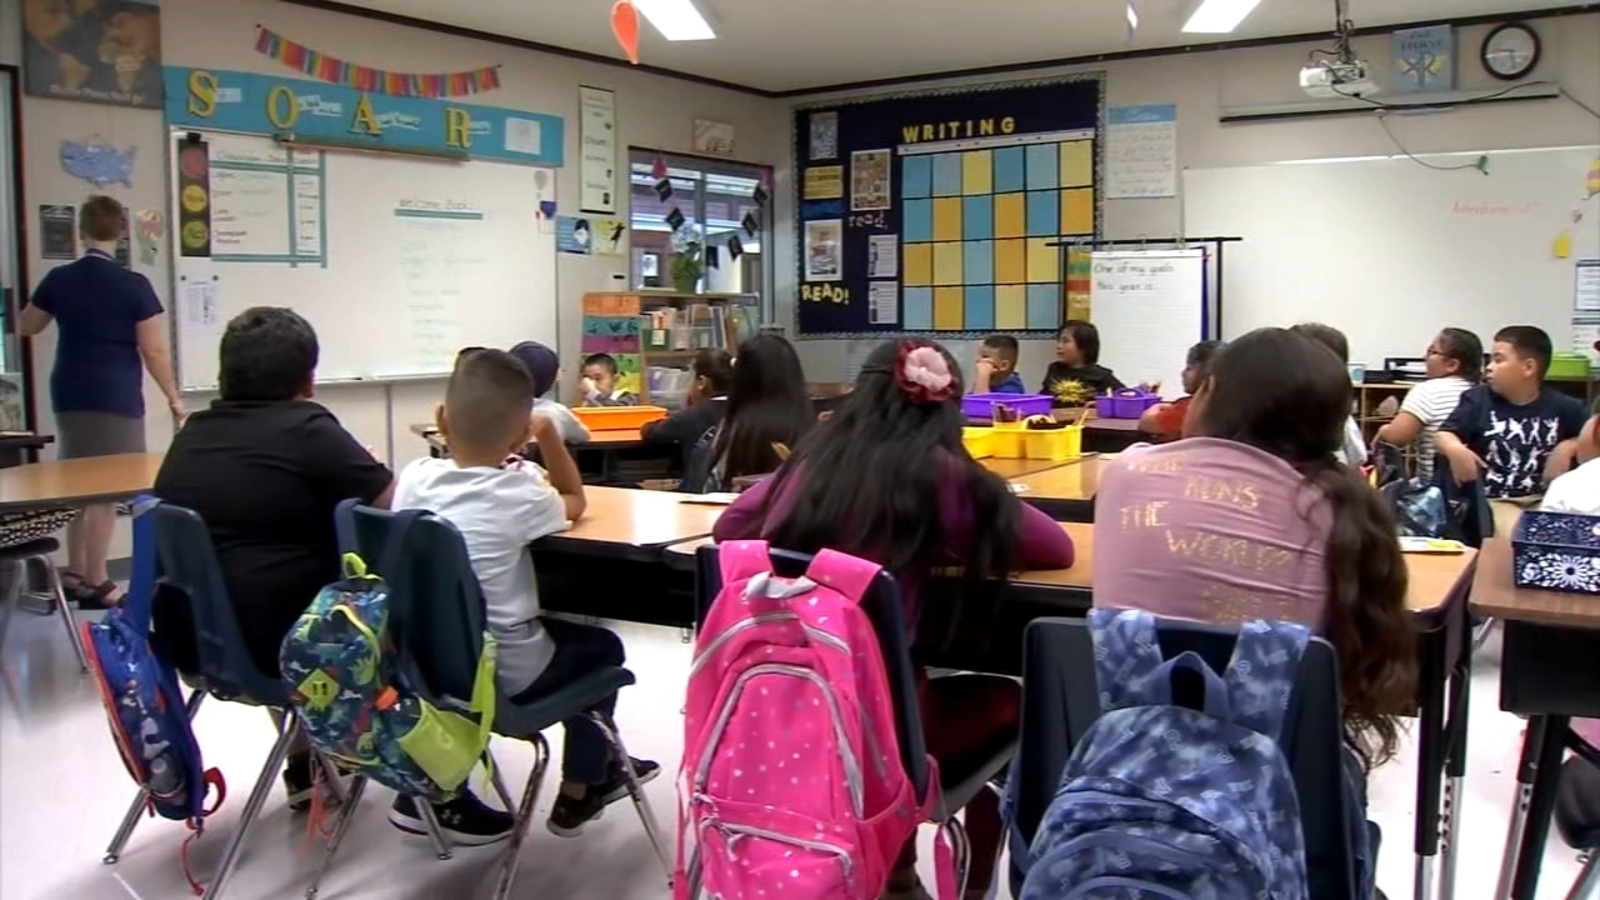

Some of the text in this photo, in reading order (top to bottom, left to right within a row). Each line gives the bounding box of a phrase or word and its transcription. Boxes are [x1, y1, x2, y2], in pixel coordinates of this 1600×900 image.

[902, 116, 1016, 144] WRITING
[1094, 263, 1113, 274] One
[1116, 261, 1129, 273] of
[1130, 266, 1146, 277] my
[801, 282, 850, 305] READ!
[1185, 474, 1259, 511] RUNS
[1119, 500, 1170, 530] THE
